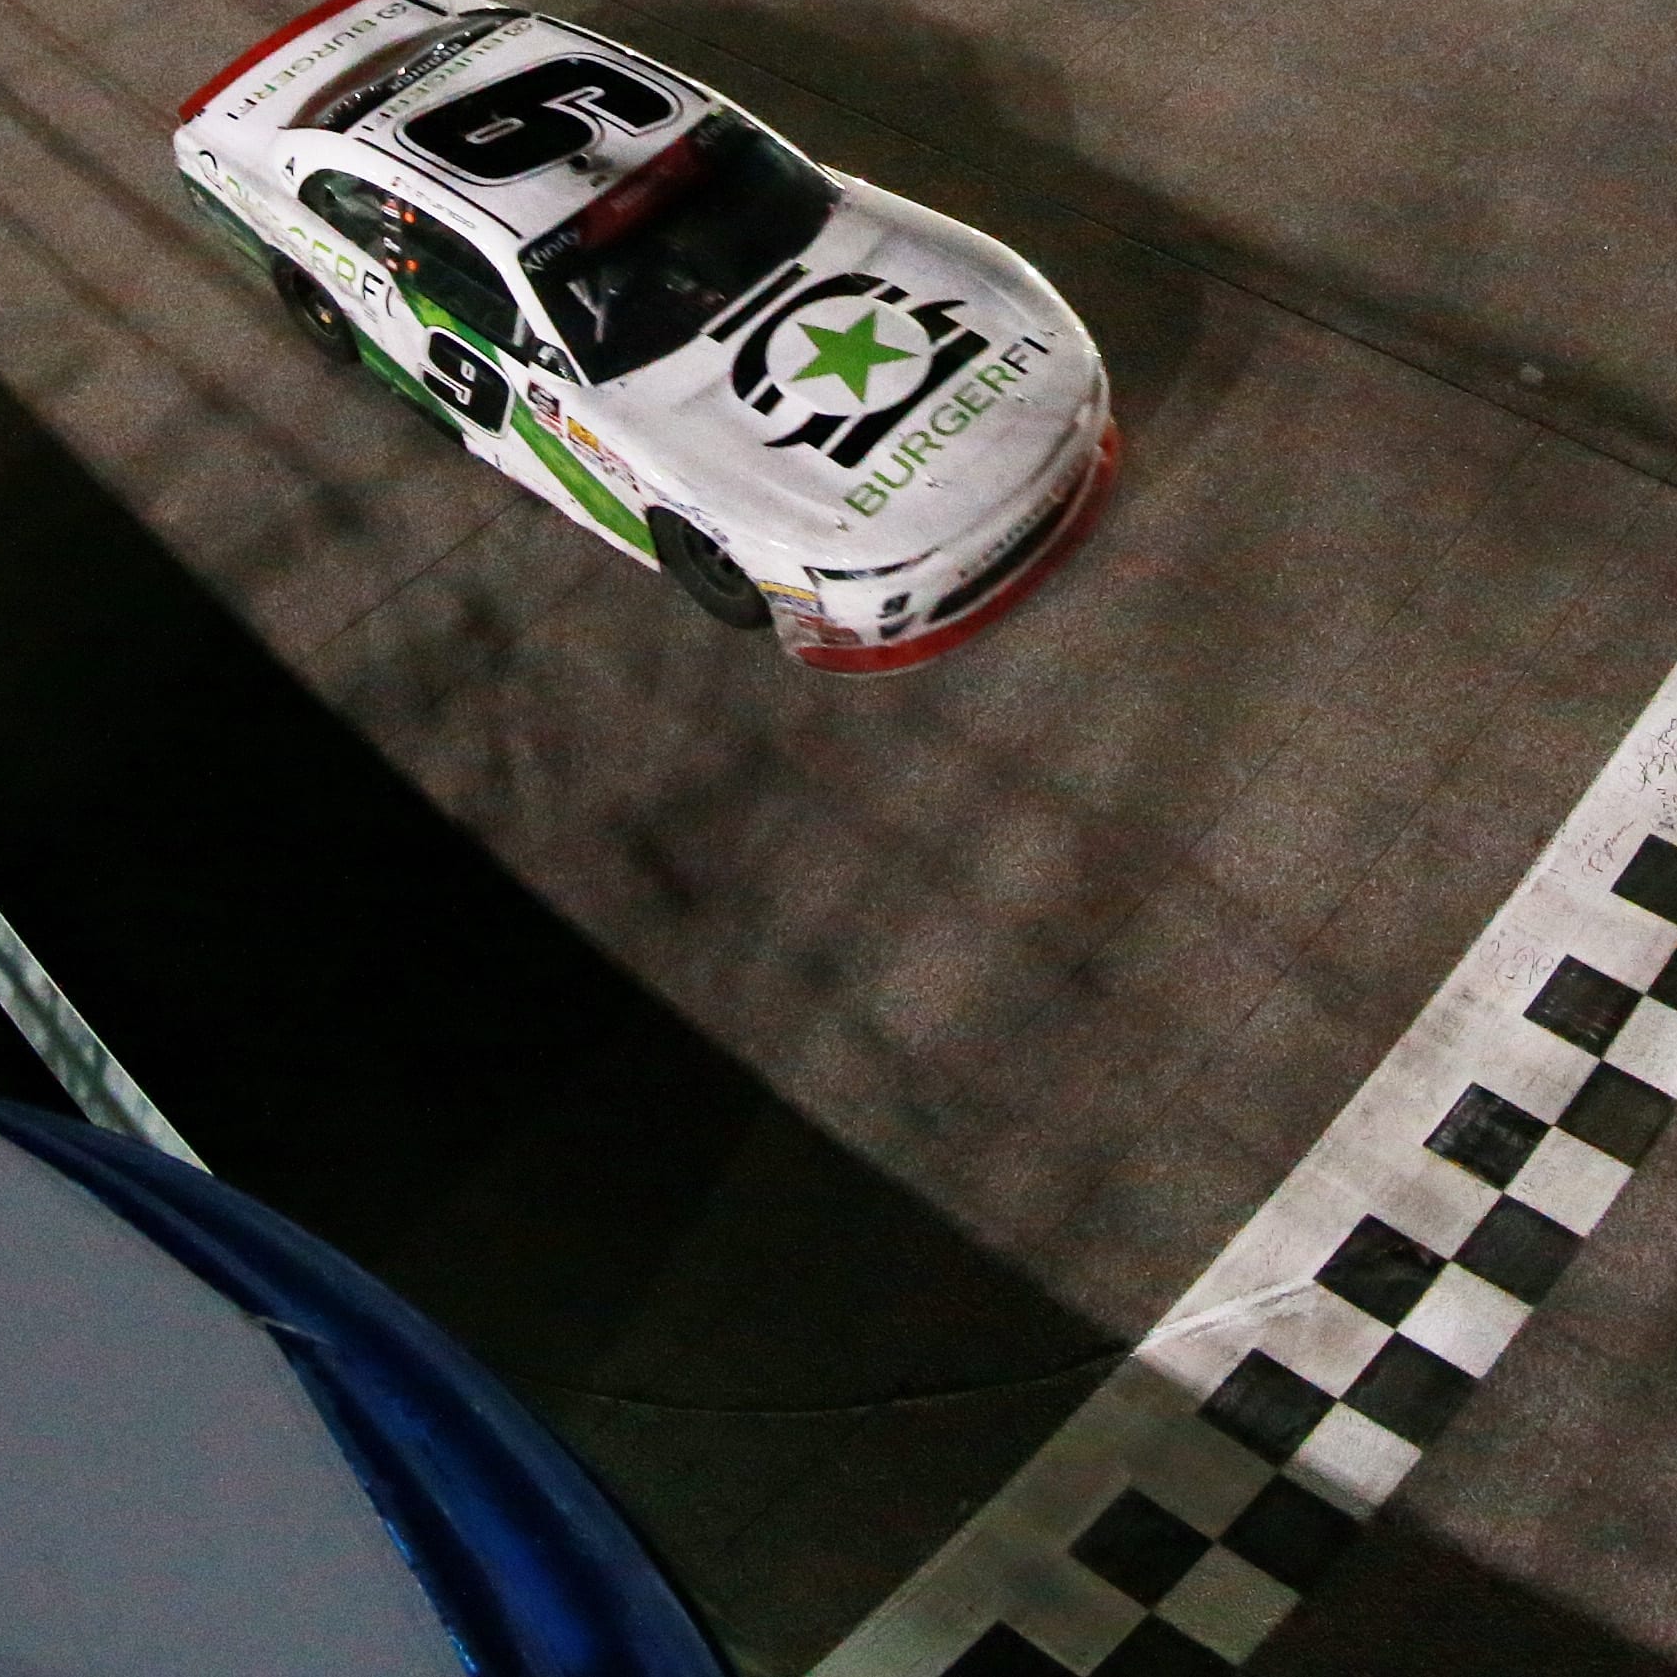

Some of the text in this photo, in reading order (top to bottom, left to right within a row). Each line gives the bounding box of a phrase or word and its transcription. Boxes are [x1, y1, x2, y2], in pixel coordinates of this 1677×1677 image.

[398, 54, 680, 185] 9
[419, 326, 514, 437] 9
[842, 335, 1052, 518] BURGERFI
